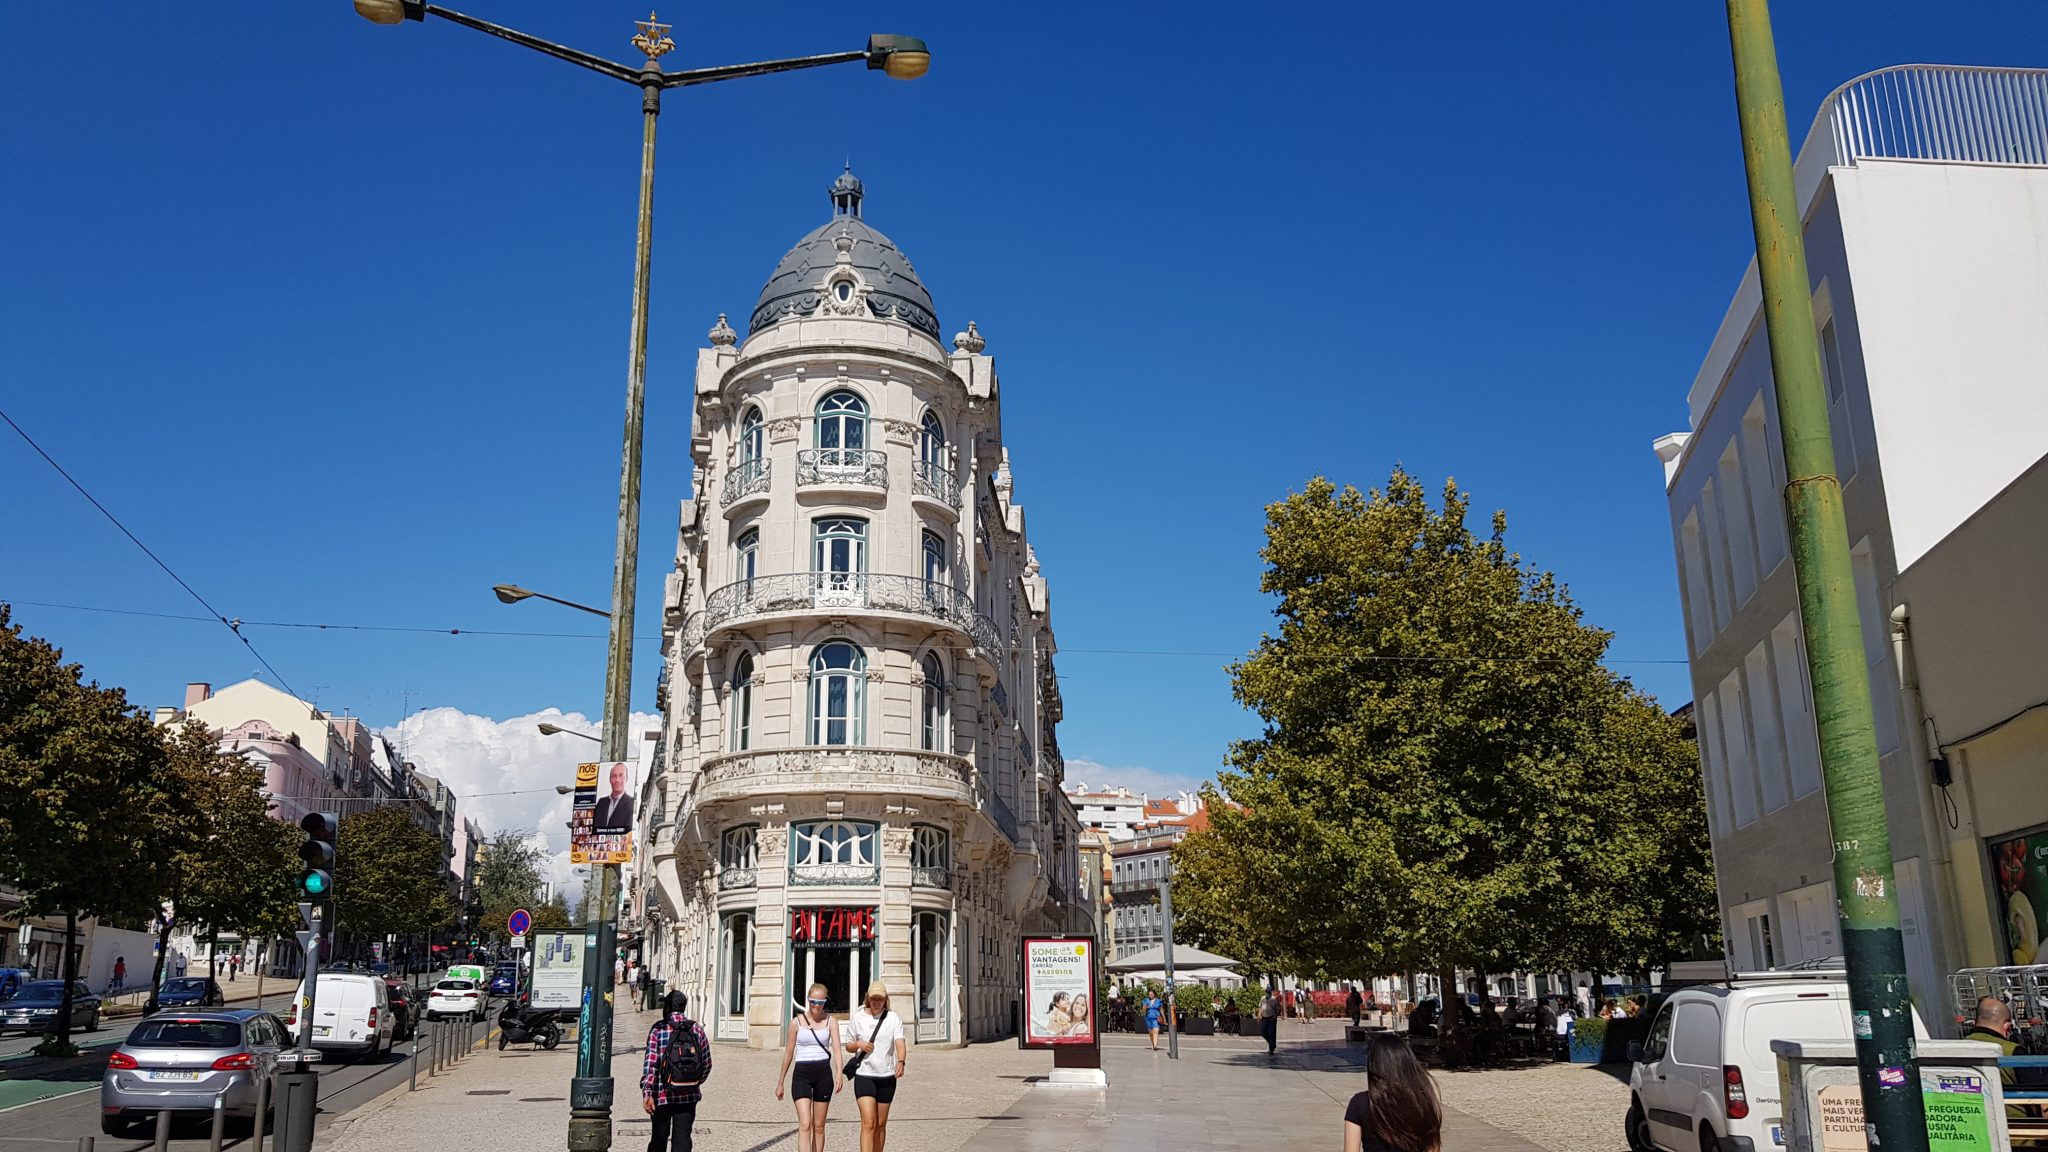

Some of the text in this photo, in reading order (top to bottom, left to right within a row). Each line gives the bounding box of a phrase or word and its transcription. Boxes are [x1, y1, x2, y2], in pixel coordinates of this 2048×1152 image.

[791, 907, 876, 940] INFAME
[1032, 948, 1058, 956] SOME
[1822, 1098, 1862, 1106] UMA FRE
[1823, 1107, 1845, 1115] MAIS
[1929, 1105, 1981, 1114] FREGUESIA
[1825, 1124, 1831, 1132] E
[1927, 1122, 1957, 1131] USIVA
